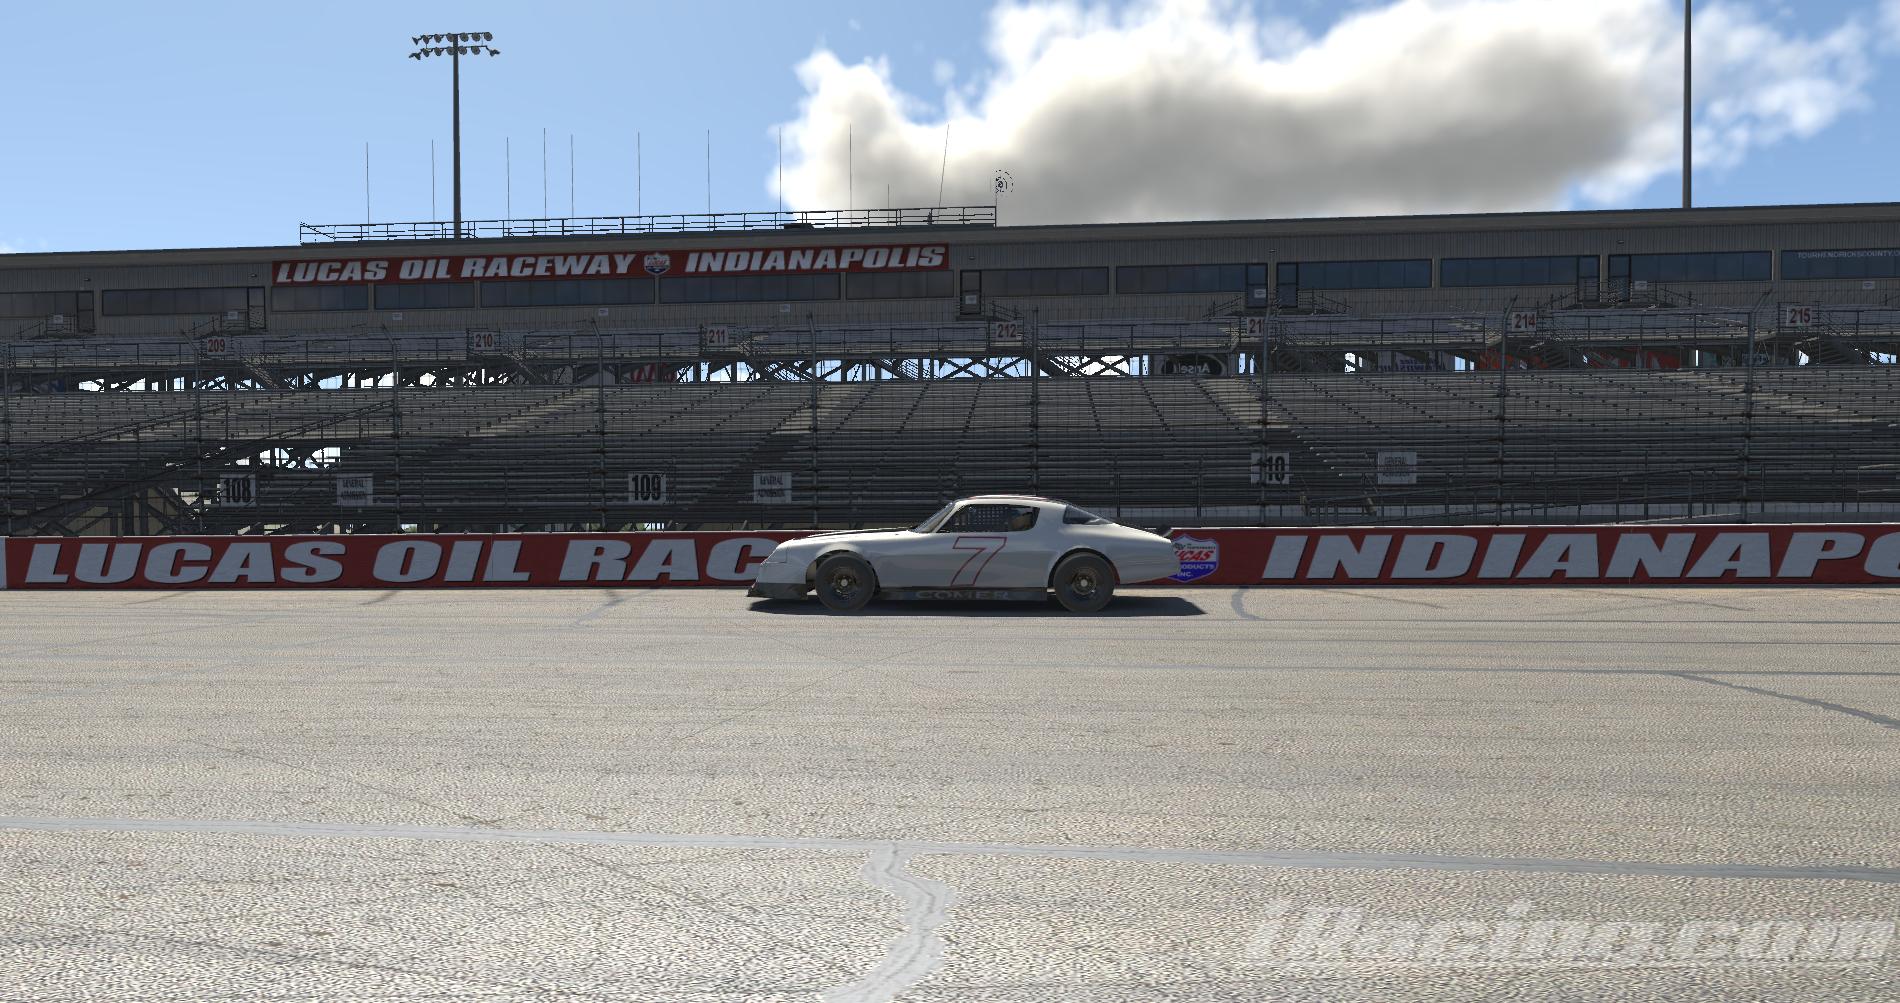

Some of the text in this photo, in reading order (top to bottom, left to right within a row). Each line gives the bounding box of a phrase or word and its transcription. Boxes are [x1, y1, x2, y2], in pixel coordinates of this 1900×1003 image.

[276, 260, 389, 283] LUCAS
[399, 258, 451, 280] OIL
[461, 253, 636, 278] RACEWAY
[684, 245, 946, 273] INDIANAPOLIS
[1514, 313, 1536, 329] 214
[1790, 308, 1811, 323] 215
[997, 323, 1017, 338] 212
[1248, 318, 1265, 334] 21
[475, 333, 493, 347] 210
[708, 329, 726, 344] 211
[207, 338, 225, 353] 209
[223, 478, 252, 503] 108
[631, 474, 662, 501] 109
[25, 540, 347, 584] LUCAS
[372, 539, 532, 583] OIL
[950, 536, 1008, 590] 7
